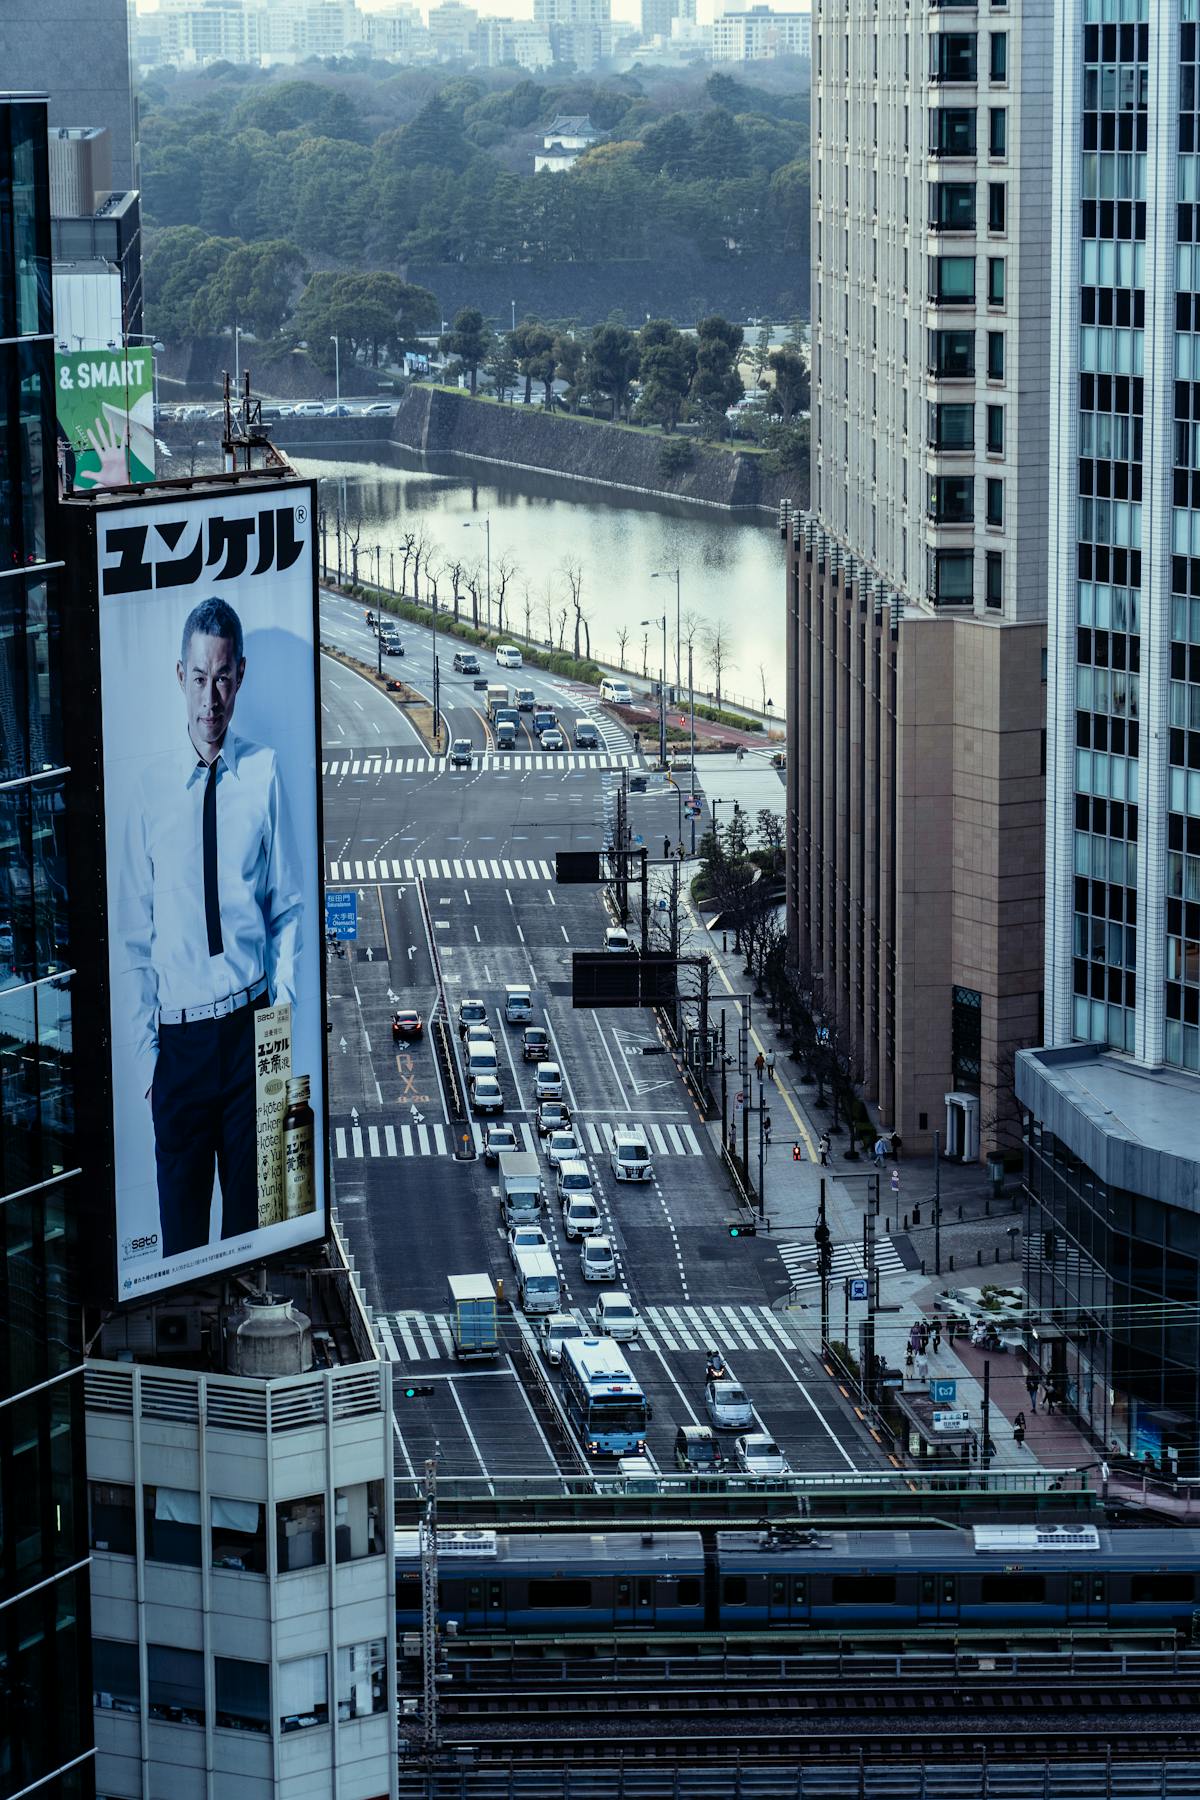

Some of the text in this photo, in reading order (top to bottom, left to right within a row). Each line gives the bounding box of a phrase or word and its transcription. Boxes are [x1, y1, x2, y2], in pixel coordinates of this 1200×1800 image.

[59, 359, 145, 390] & SMART
[256, 1012, 275, 1023] sato
[257, 1037, 290, 1057] ユンケル
[131, 1234, 158, 1249] sato
